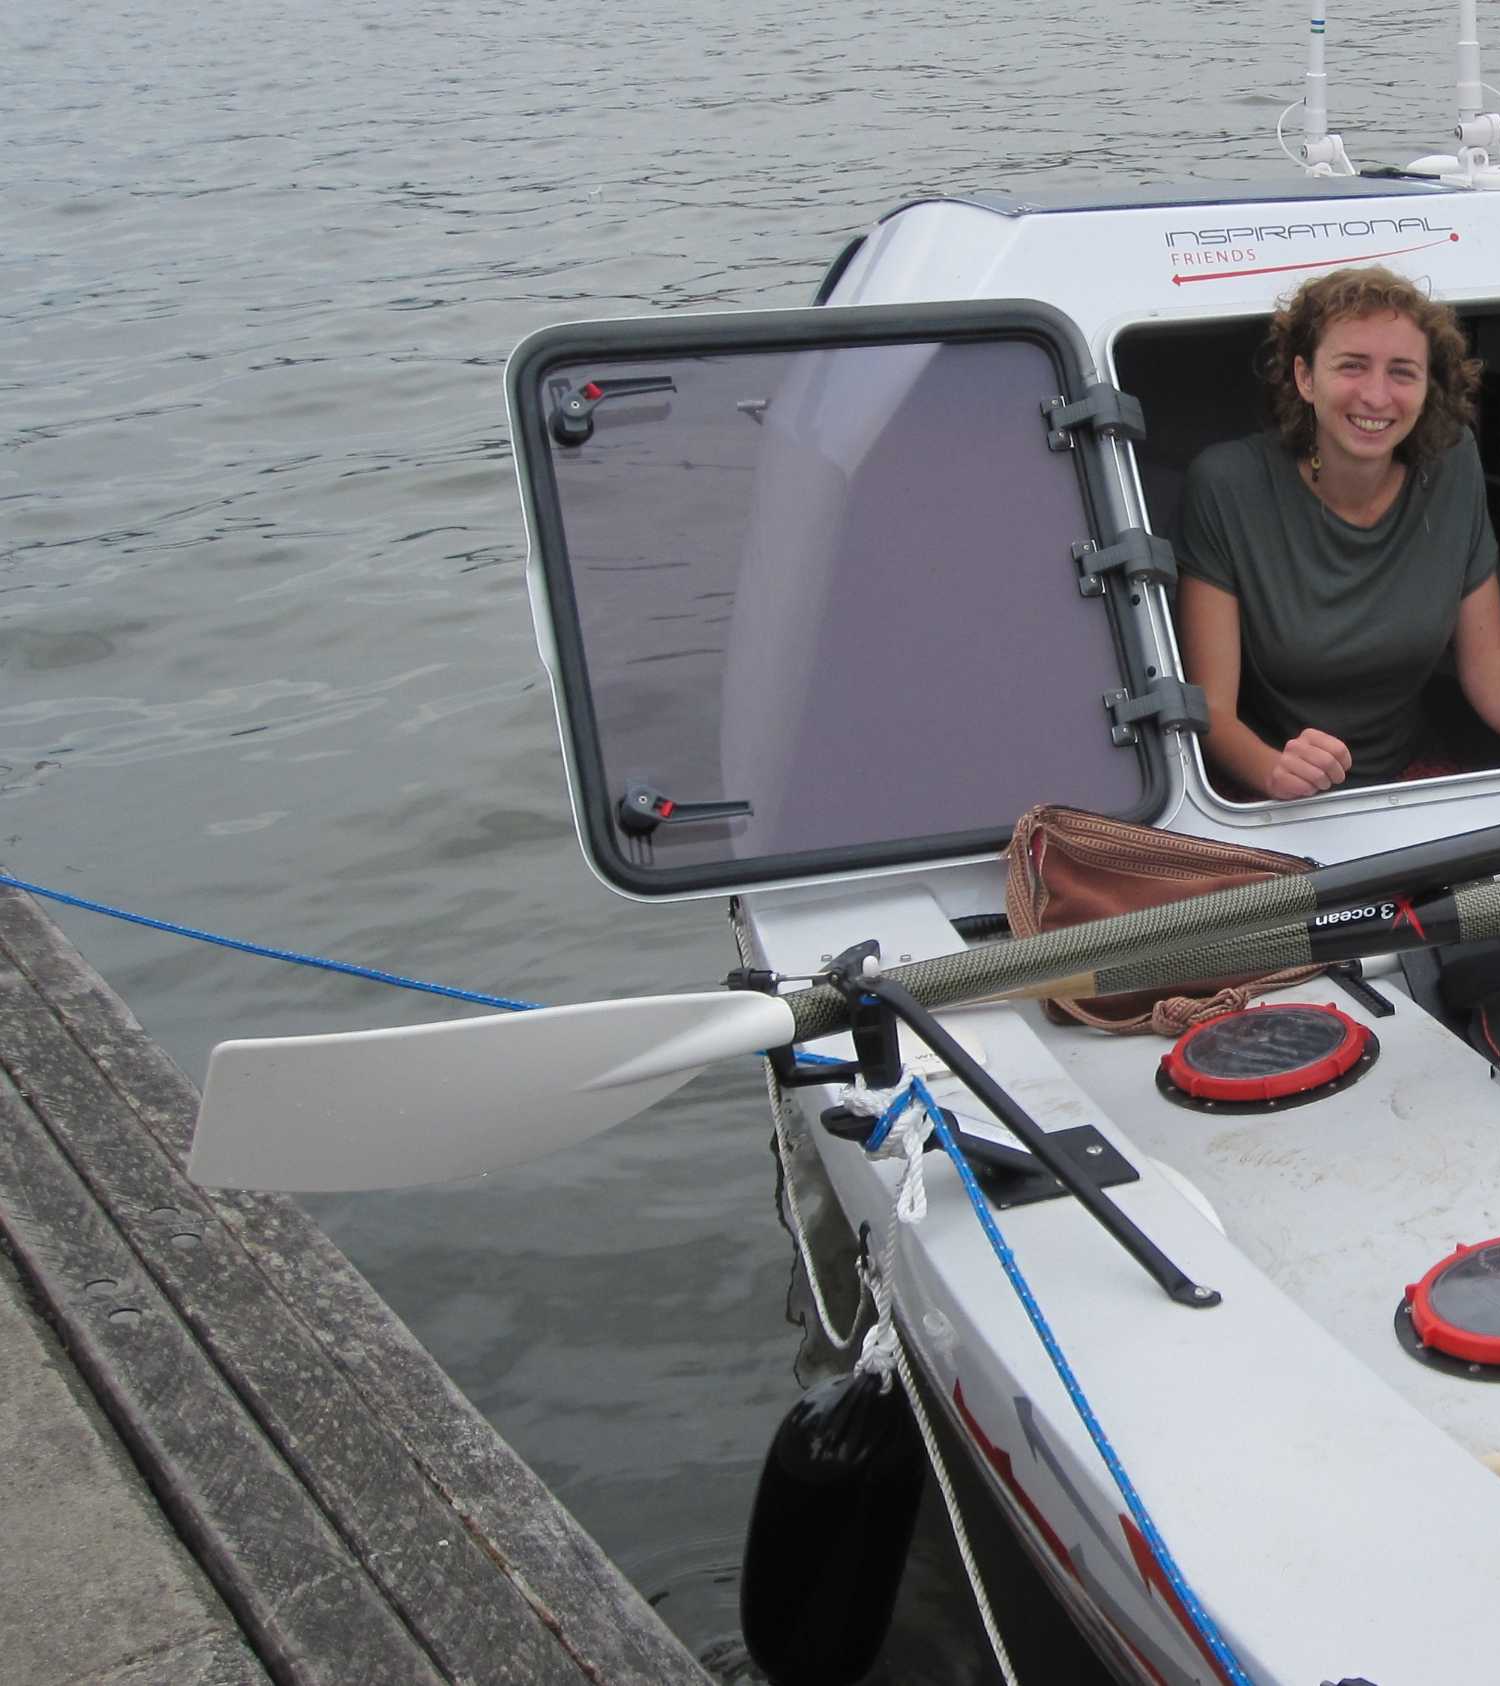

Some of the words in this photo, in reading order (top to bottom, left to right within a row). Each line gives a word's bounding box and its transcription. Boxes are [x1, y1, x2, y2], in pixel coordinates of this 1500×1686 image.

[1164, 217, 1453, 248] INSPIRATIONAL
[1171, 248, 1257, 266] FRIENDS
[1315, 906, 1376, 926] ocean
